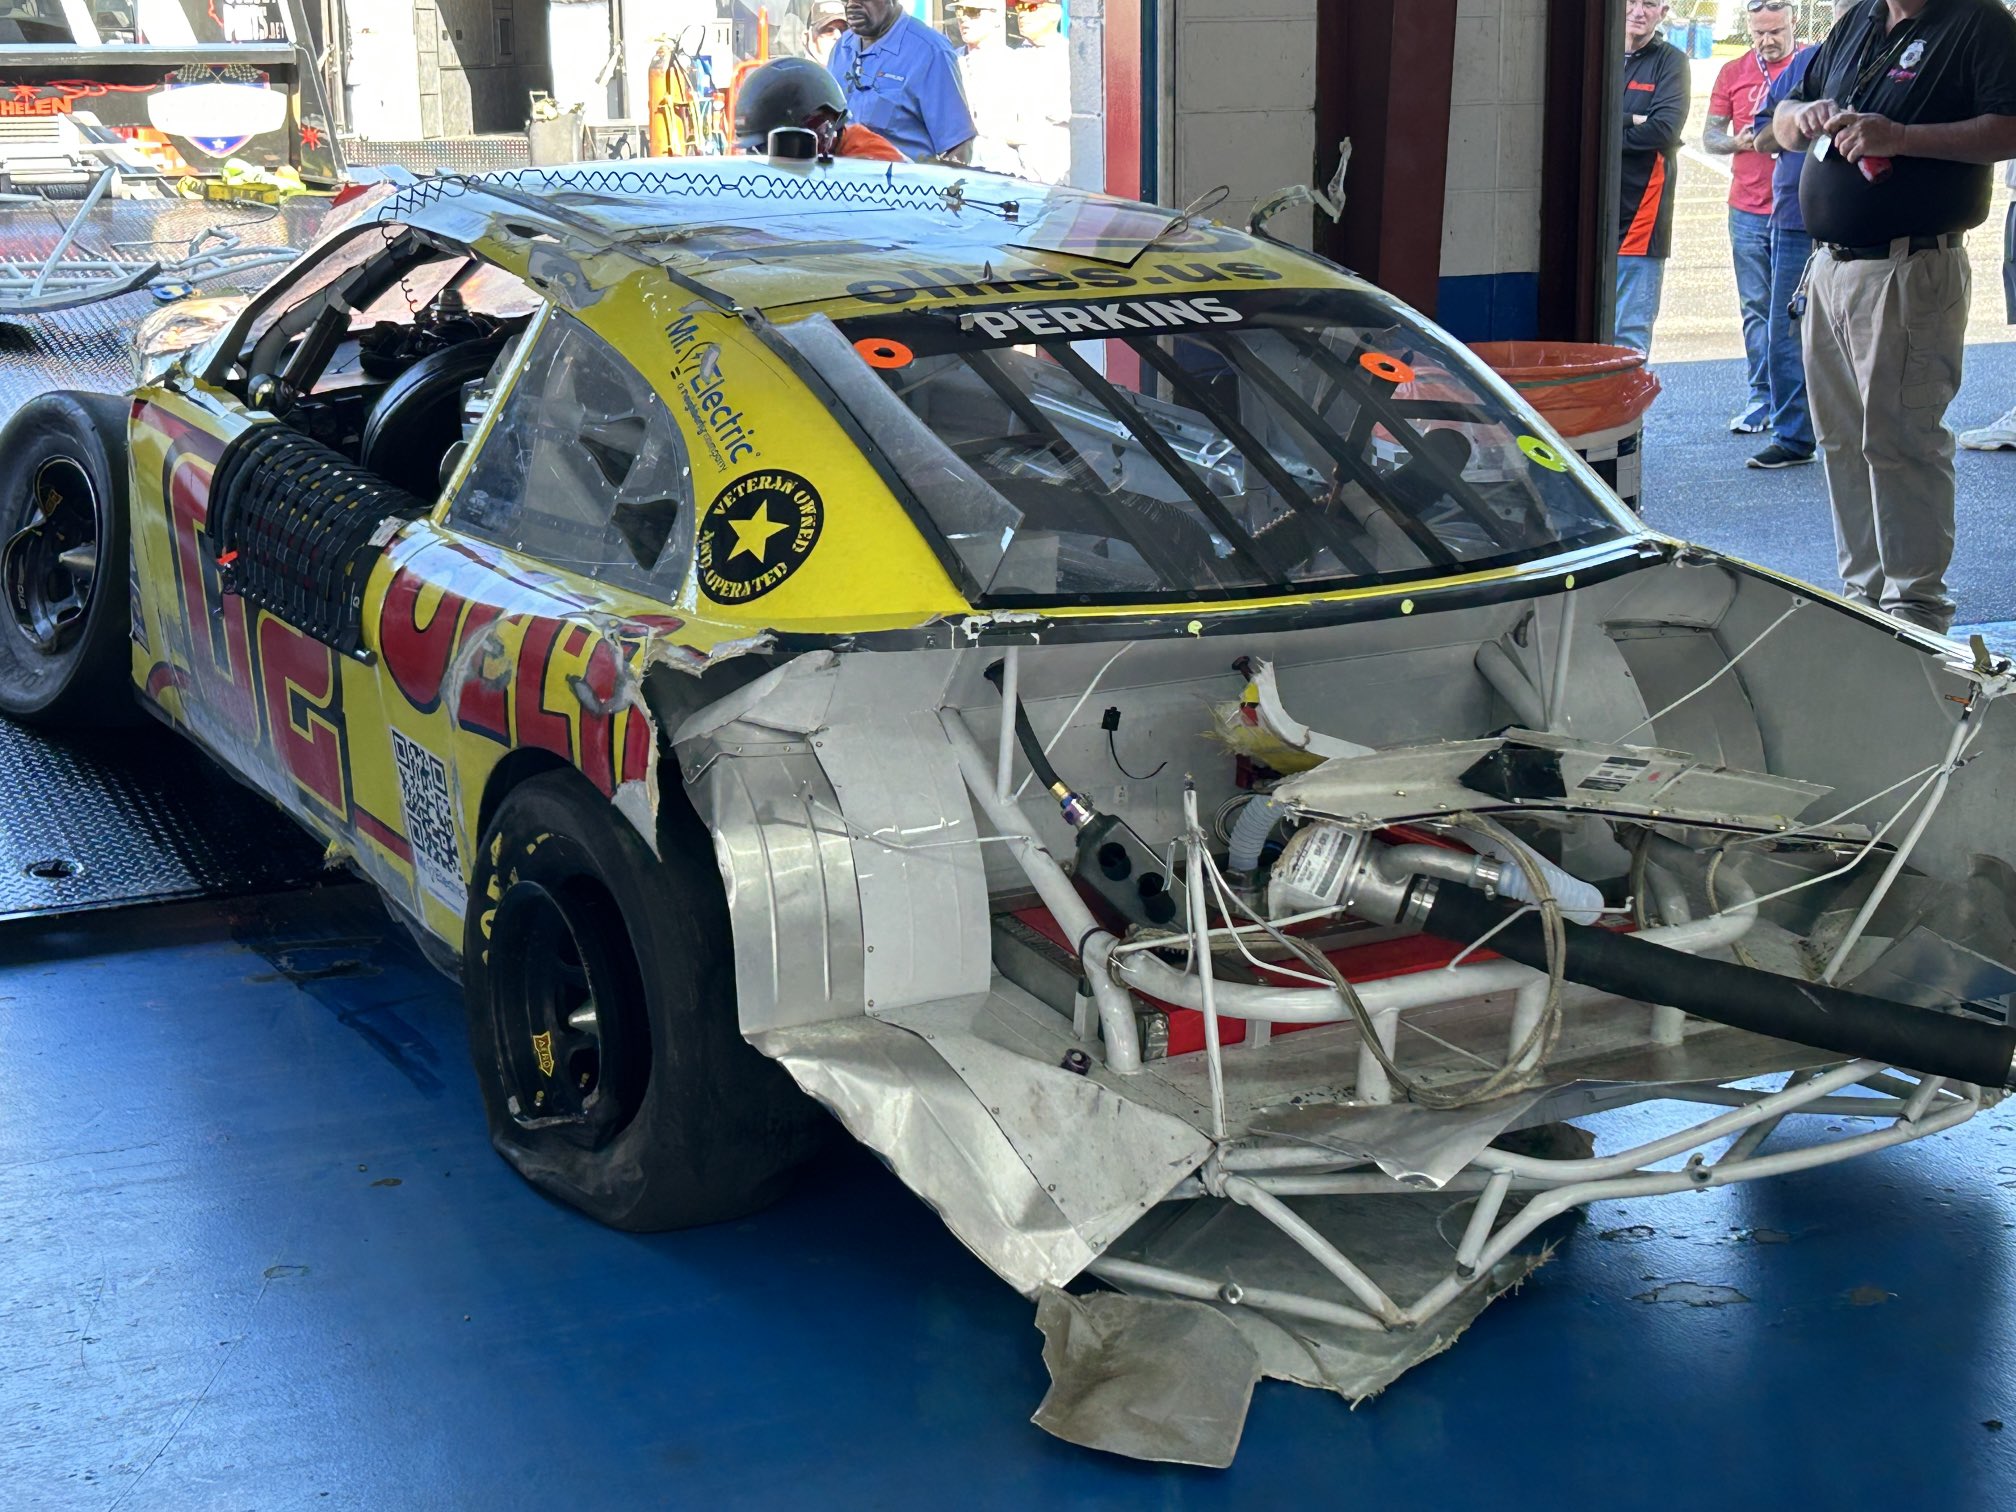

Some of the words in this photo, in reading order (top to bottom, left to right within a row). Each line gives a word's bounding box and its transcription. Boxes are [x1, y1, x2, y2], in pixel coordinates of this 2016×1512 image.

[973, 297, 1243, 339] PERKINS
[712, 475, 798, 516] VETERAN
[791, 490, 817, 553] OWNED
[704, 562, 788, 598] OPERATED
